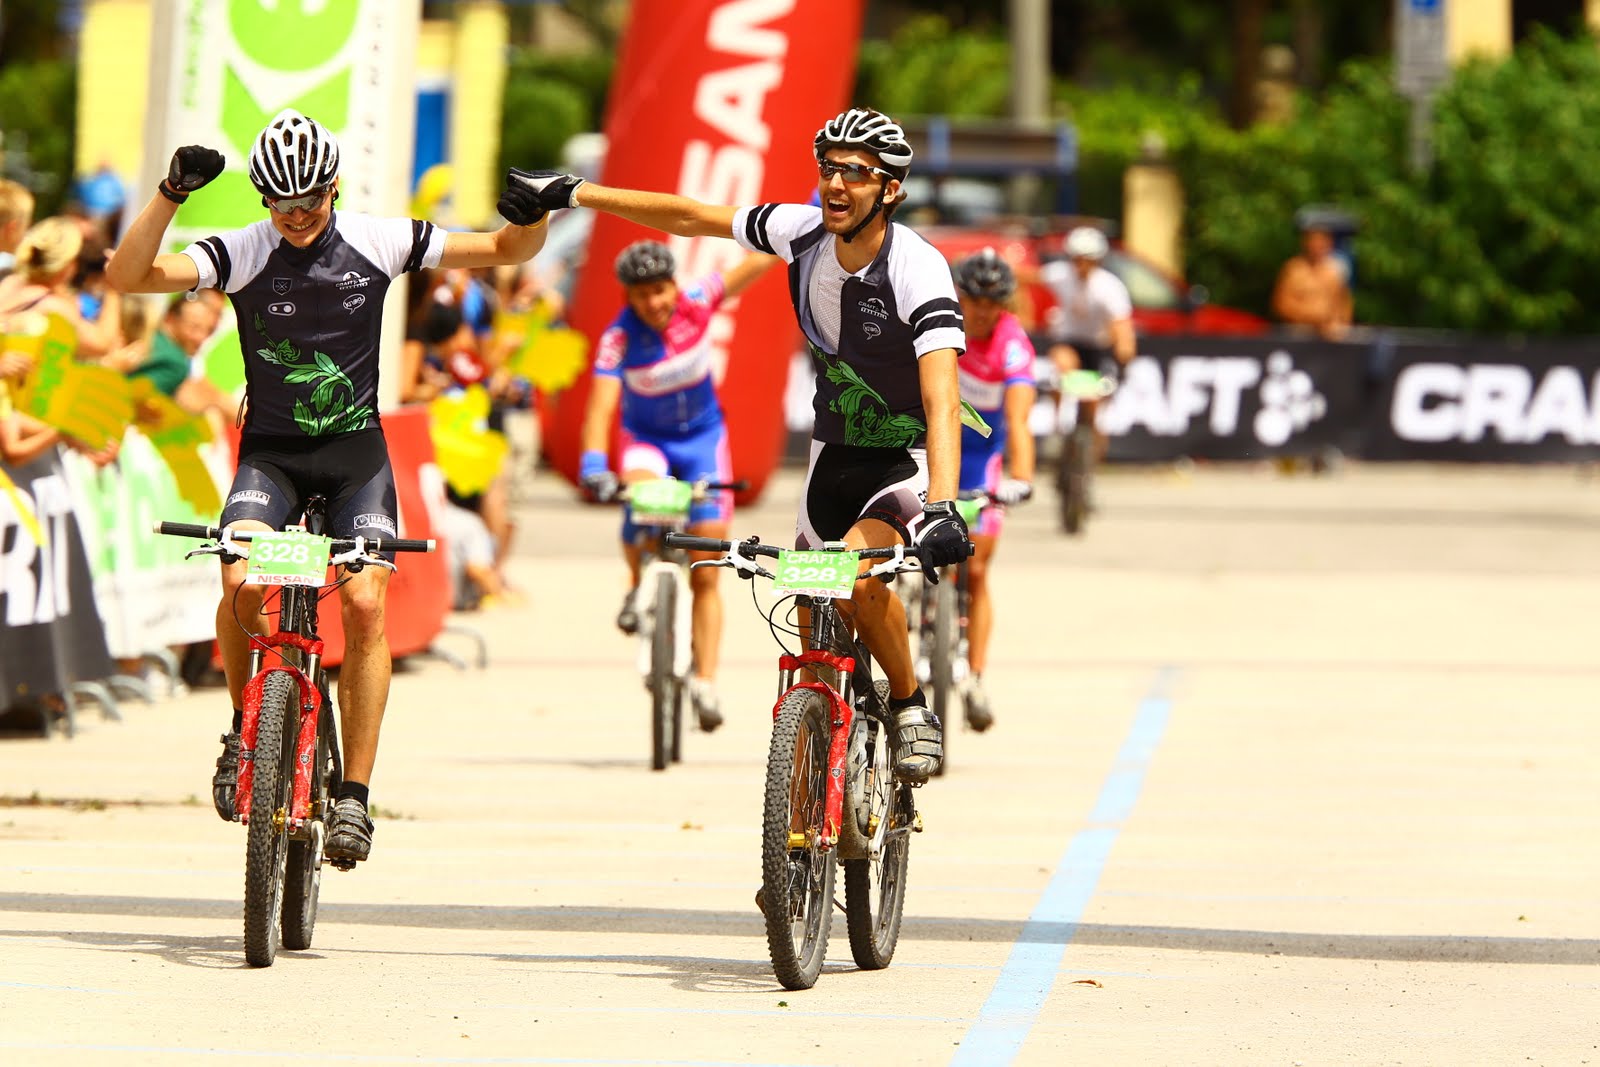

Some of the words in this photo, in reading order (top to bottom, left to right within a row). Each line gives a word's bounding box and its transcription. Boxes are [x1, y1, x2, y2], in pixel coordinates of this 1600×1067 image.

[1391, 363, 1600, 445] CRA
[255, 541, 309, 565] 328
[314, 555, 322, 568] 1
[787, 553, 837, 565] CRAFT
[257, 575, 314, 585] NISSAN
[782, 566, 837, 583] 328
[839, 575, 851, 583] 2
[782, 587, 841, 597] NISSAN
